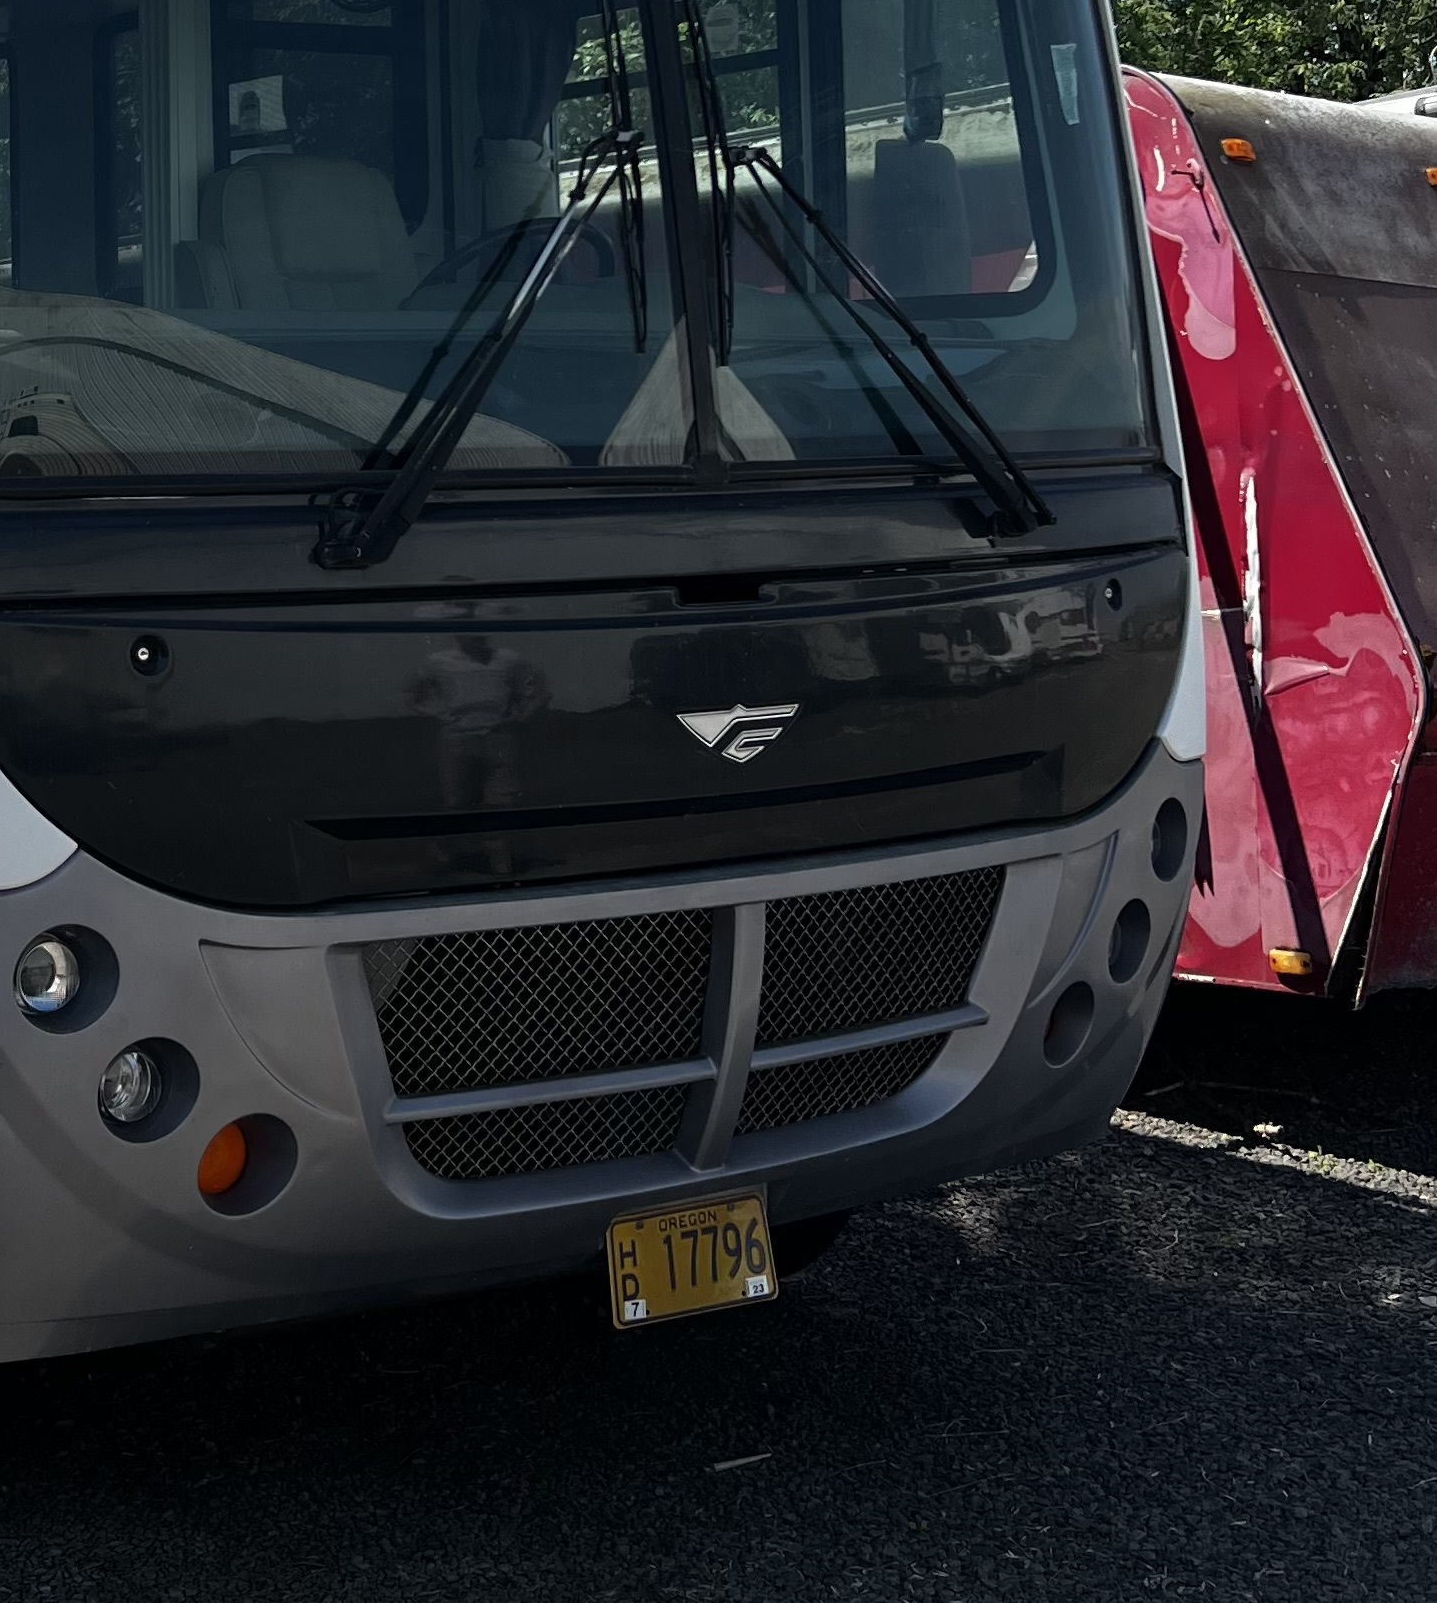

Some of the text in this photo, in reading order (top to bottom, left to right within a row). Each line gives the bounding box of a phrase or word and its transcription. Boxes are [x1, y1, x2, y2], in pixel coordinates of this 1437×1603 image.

[658, 1210, 718, 1232] OREGON
[663, 1217, 767, 1293] 17796
[752, 1283, 765, 1294] 23
[631, 1301, 640, 1318] 7
